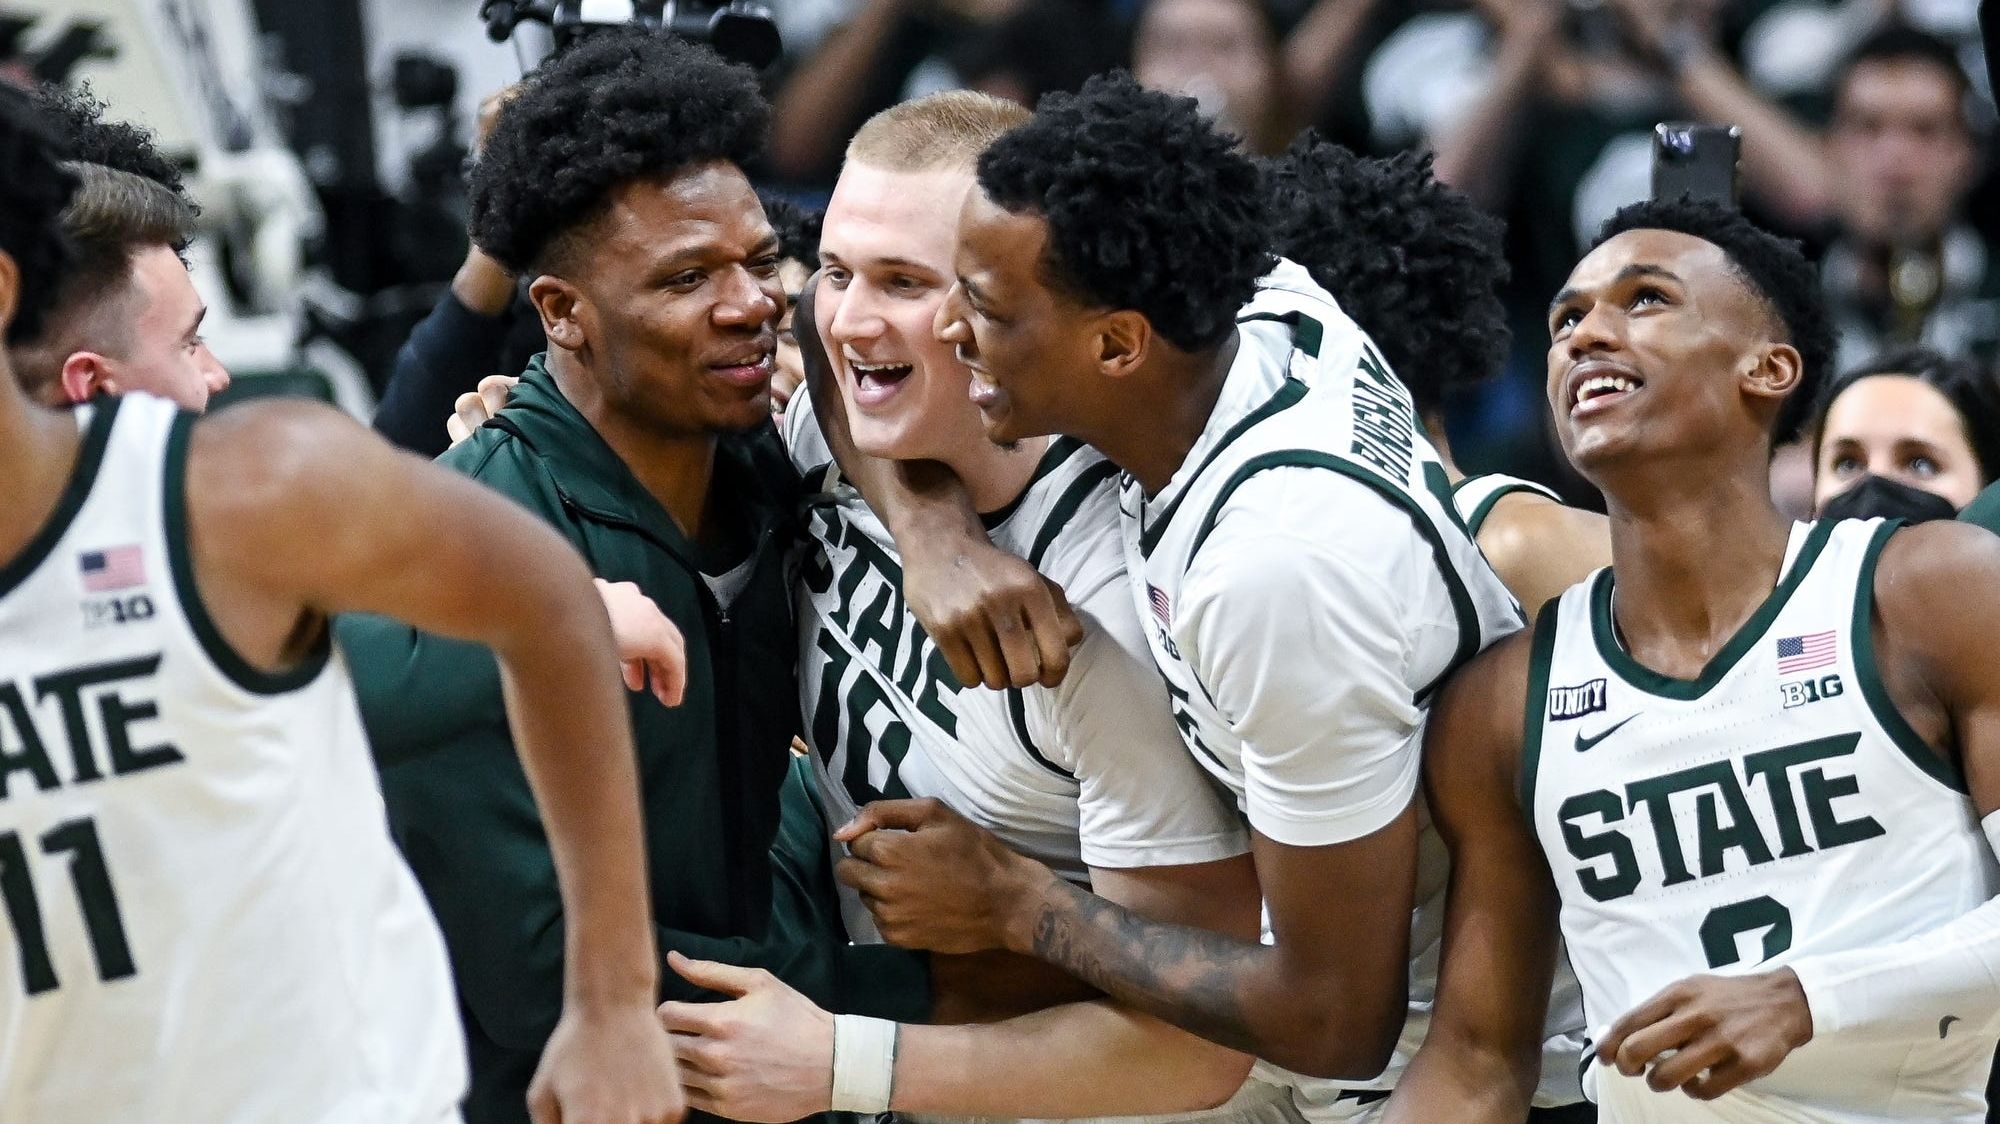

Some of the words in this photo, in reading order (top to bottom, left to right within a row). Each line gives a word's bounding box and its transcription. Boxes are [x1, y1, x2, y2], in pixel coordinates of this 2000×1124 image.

[1350, 341, 1413, 488] BINGHAM
[1550, 680, 1606, 721] UNITY
[1557, 731, 1887, 902] STATE
[0, 815, 138, 997] 11
